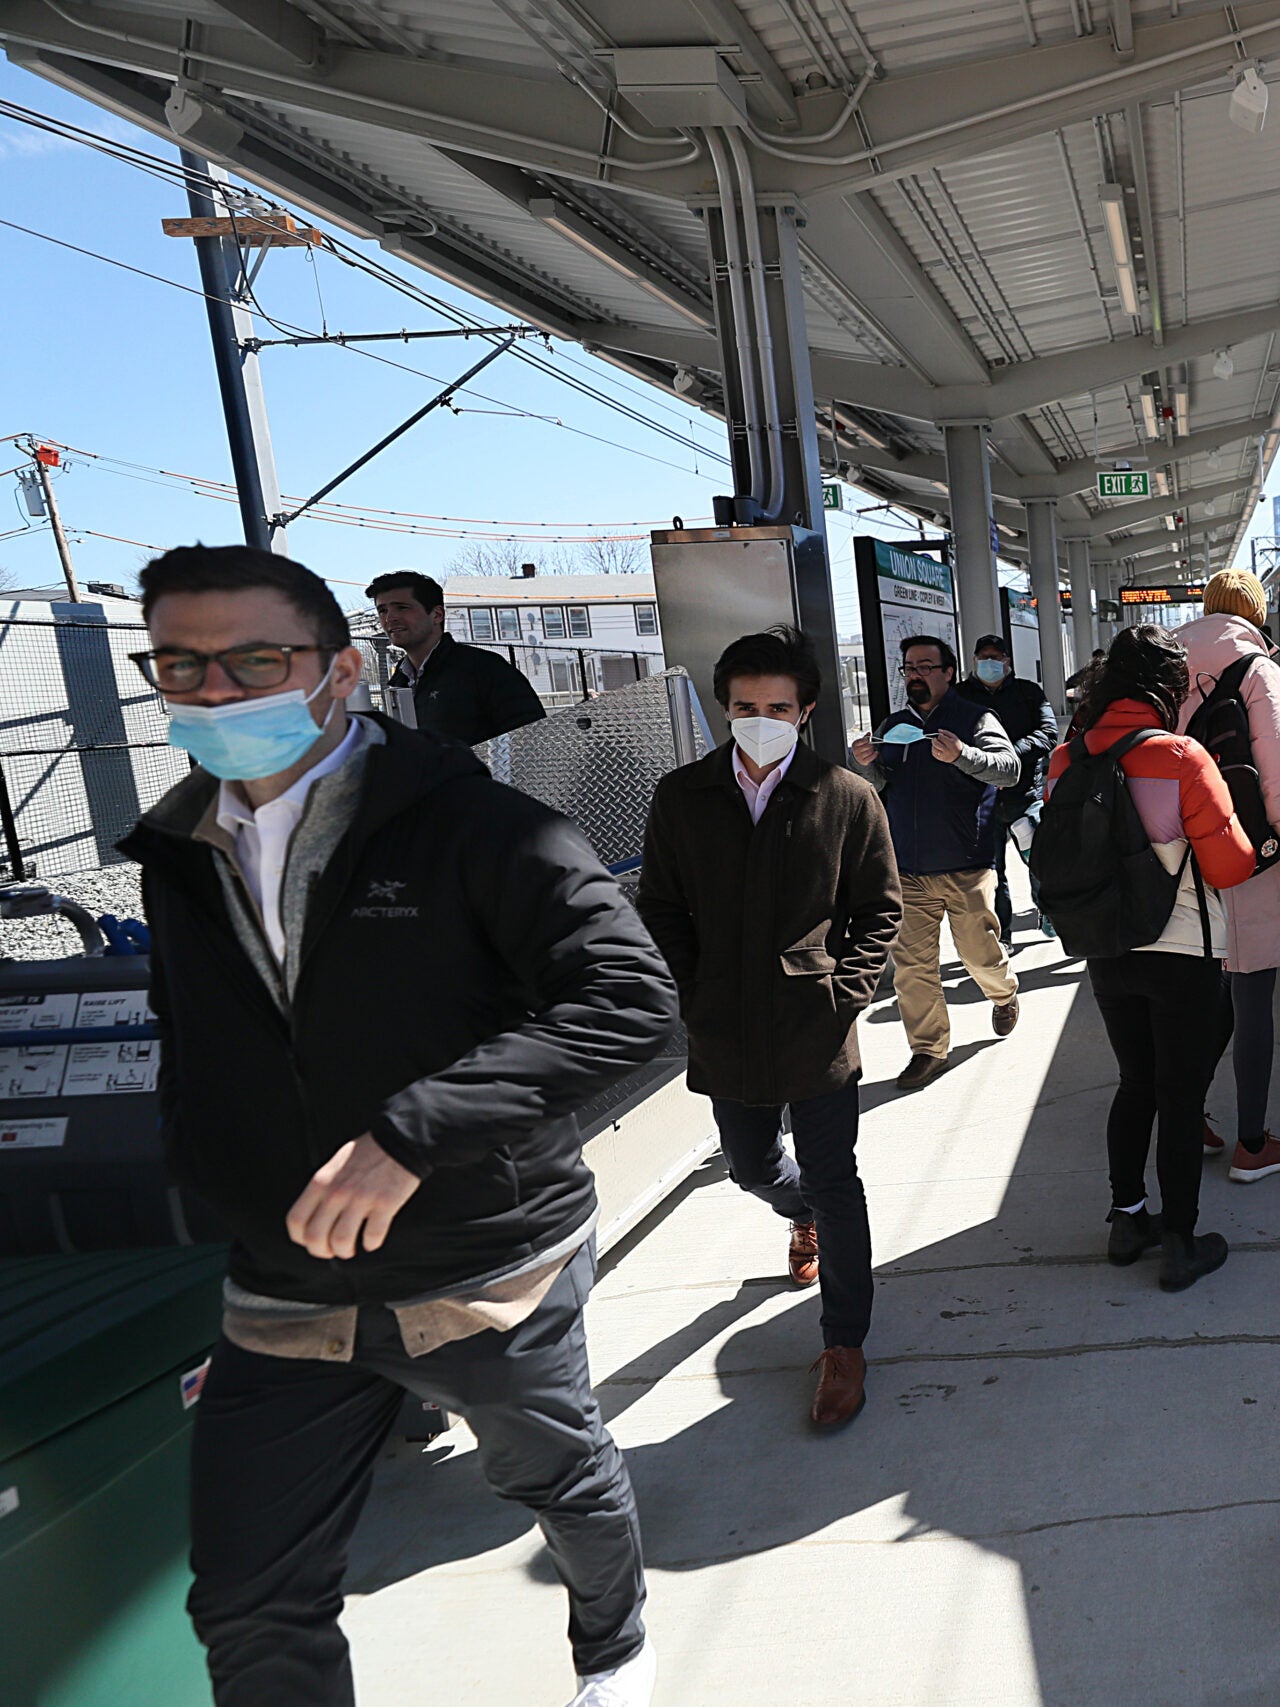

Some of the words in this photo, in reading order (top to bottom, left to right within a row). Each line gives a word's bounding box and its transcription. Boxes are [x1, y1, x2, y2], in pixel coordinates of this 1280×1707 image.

[1104, 475, 1127, 494] EXIT
[889, 550, 917, 580] UNION
[916, 559, 944, 588] SQUARE
[894, 585, 908, 599] GREEN
[908, 588, 917, 601] LINE
[108, 998, 127, 1006] LIFT
